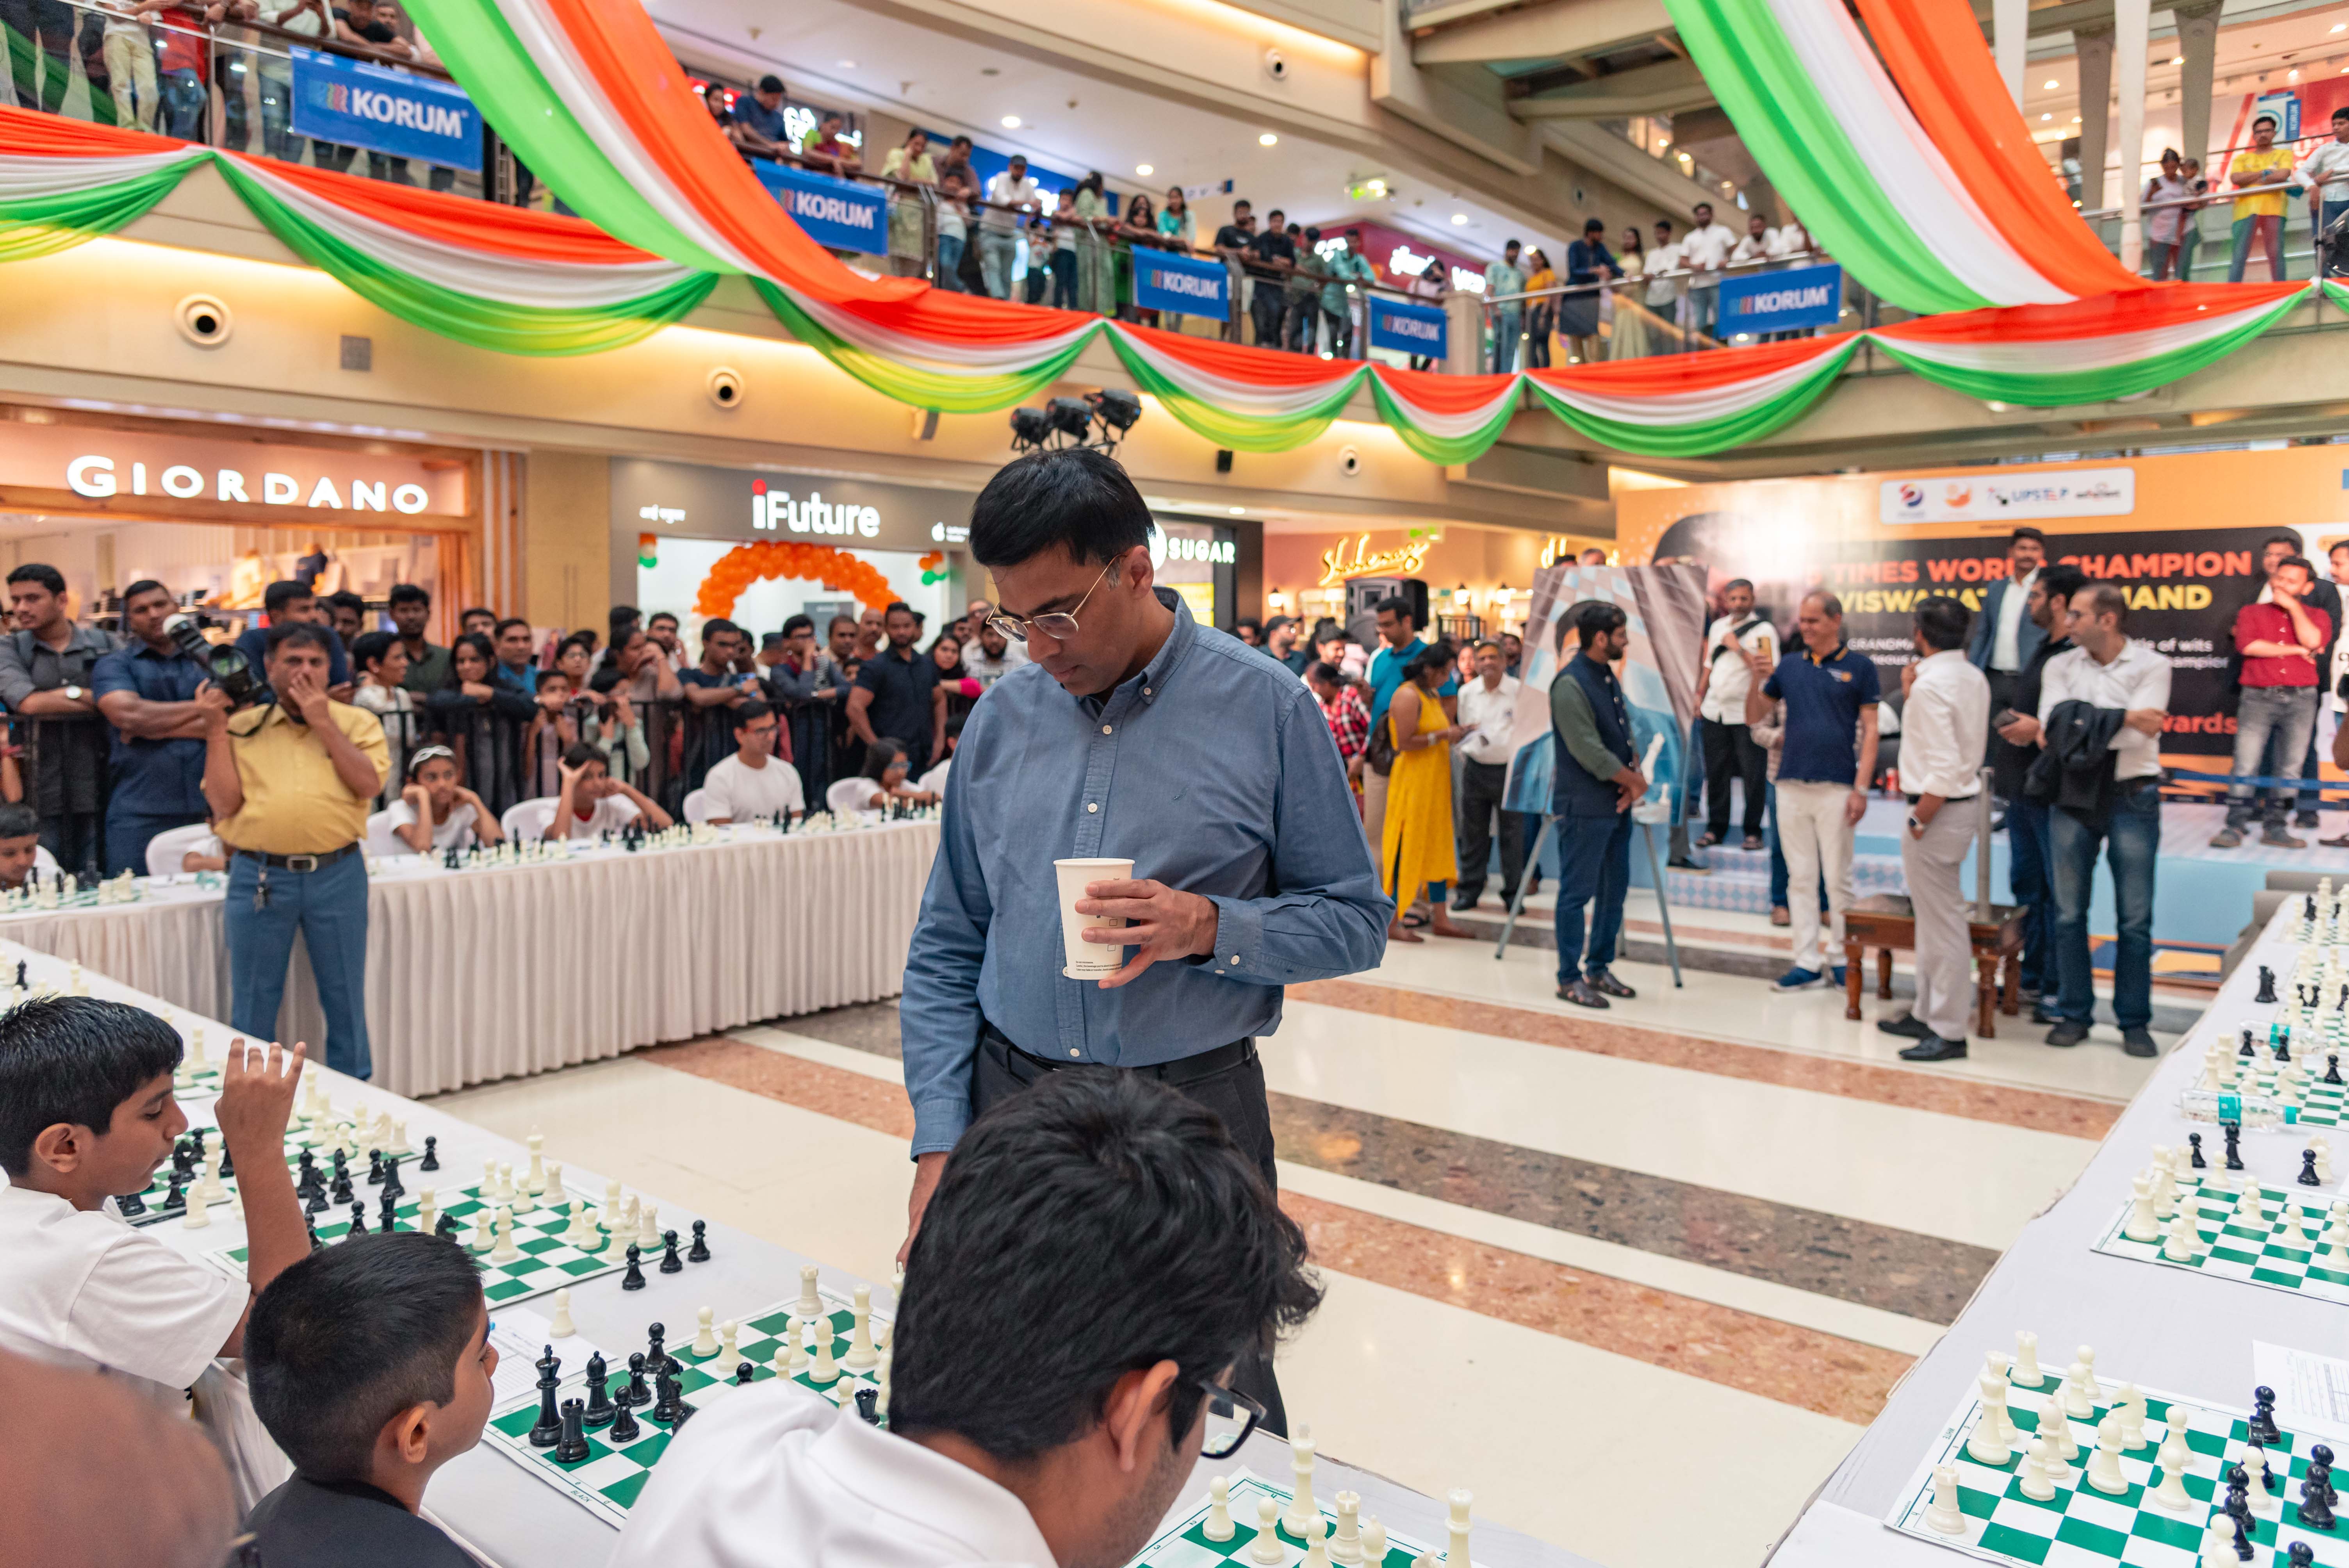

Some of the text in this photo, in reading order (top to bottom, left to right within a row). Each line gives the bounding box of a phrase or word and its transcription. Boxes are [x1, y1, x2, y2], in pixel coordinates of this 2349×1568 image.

[352, 87, 463, 139] KORUM
[795, 190, 874, 230] KORUM
[1162, 269, 1219, 300] KORUM
[1754, 285, 1828, 315] KORUM
[1391, 315, 1440, 342] KORUM
[67, 455, 429, 515] GIORDANO
[752, 479, 880, 537] iFuture
[1168, 537, 1235, 564] SUGAR
[1832, 560, 1919, 584] TIMES
[2157, 637, 2177, 652] of
[2178, 638, 2214, 652] wits
[1943, 1427, 1955, 1440] WHITE
[570, 1490, 592, 1503] BLACK
